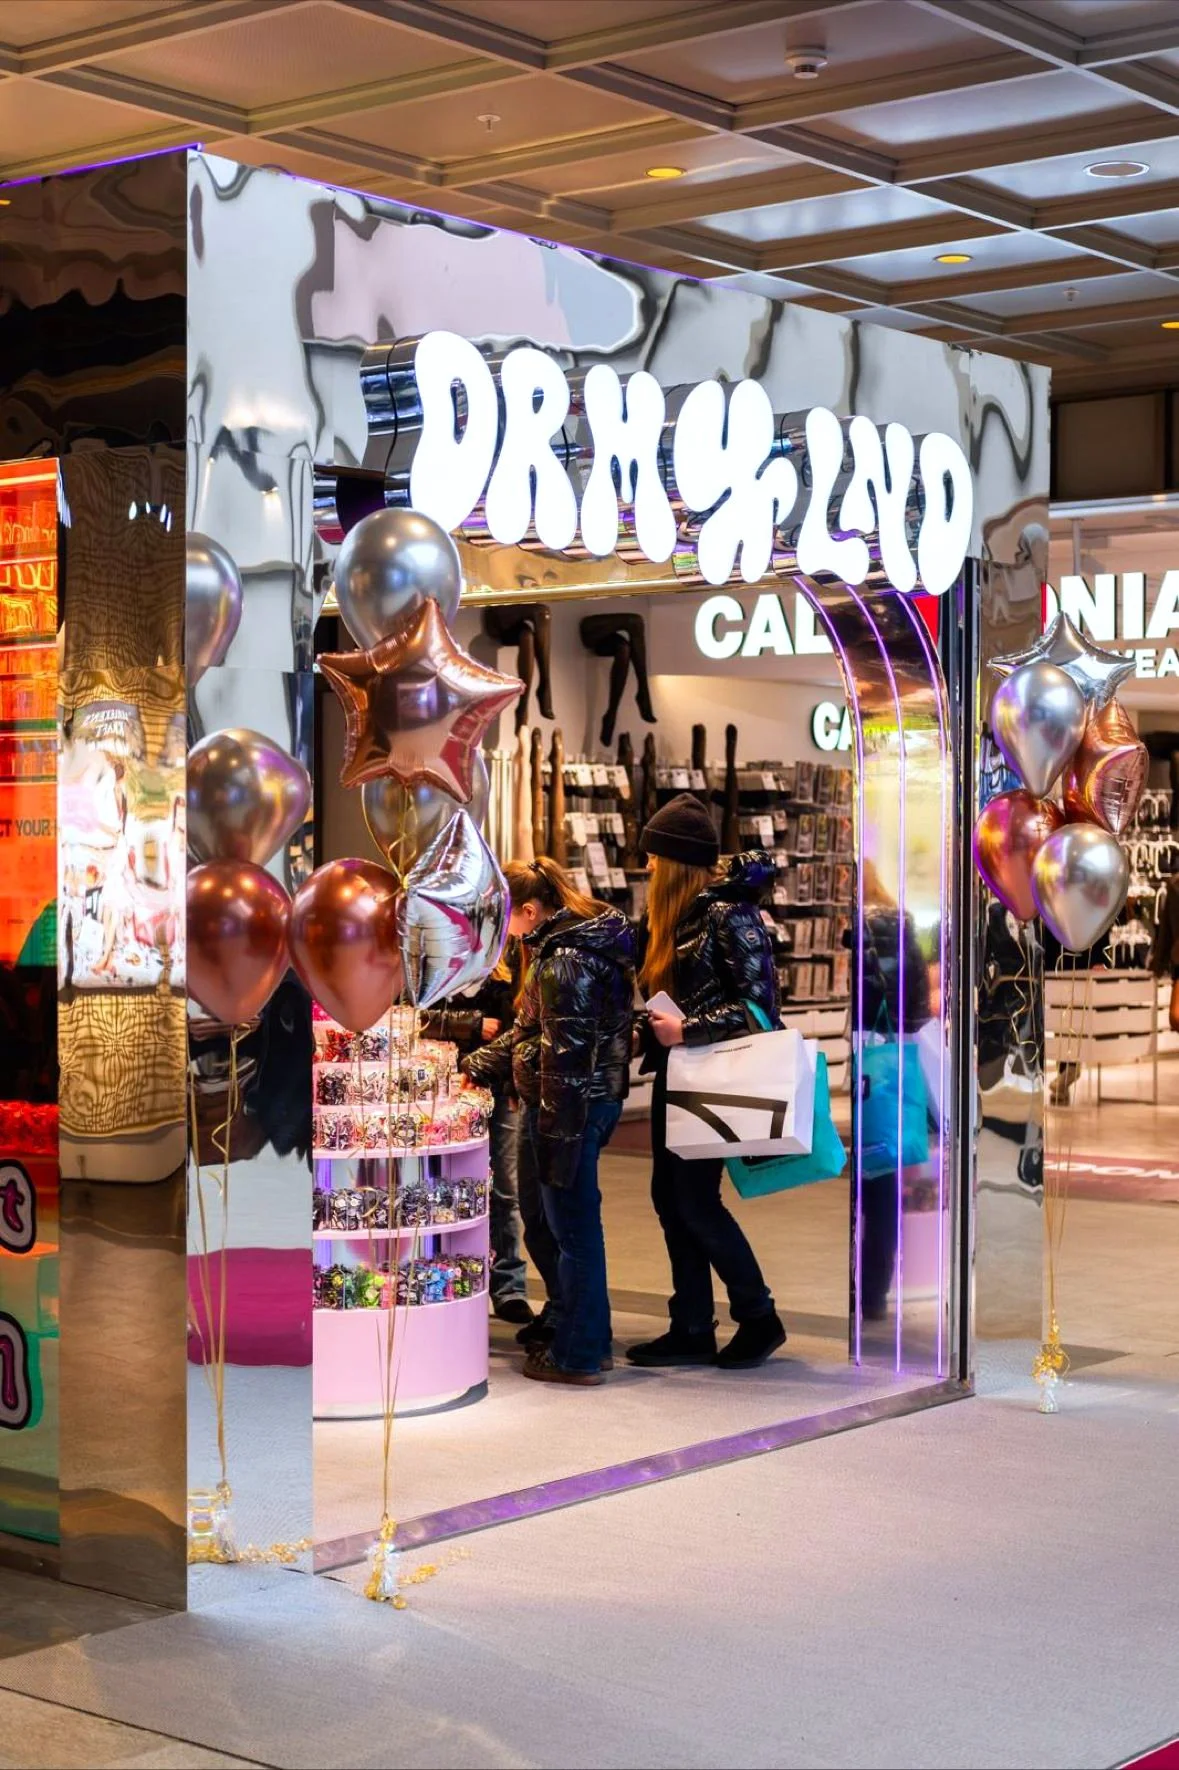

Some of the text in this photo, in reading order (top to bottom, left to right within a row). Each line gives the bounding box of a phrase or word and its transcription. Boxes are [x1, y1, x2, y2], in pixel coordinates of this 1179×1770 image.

[694, 570, 1179, 660] CAL NIA
[1110, 648, 1179, 678] EA
[15, 819, 51, 837] YOUR
